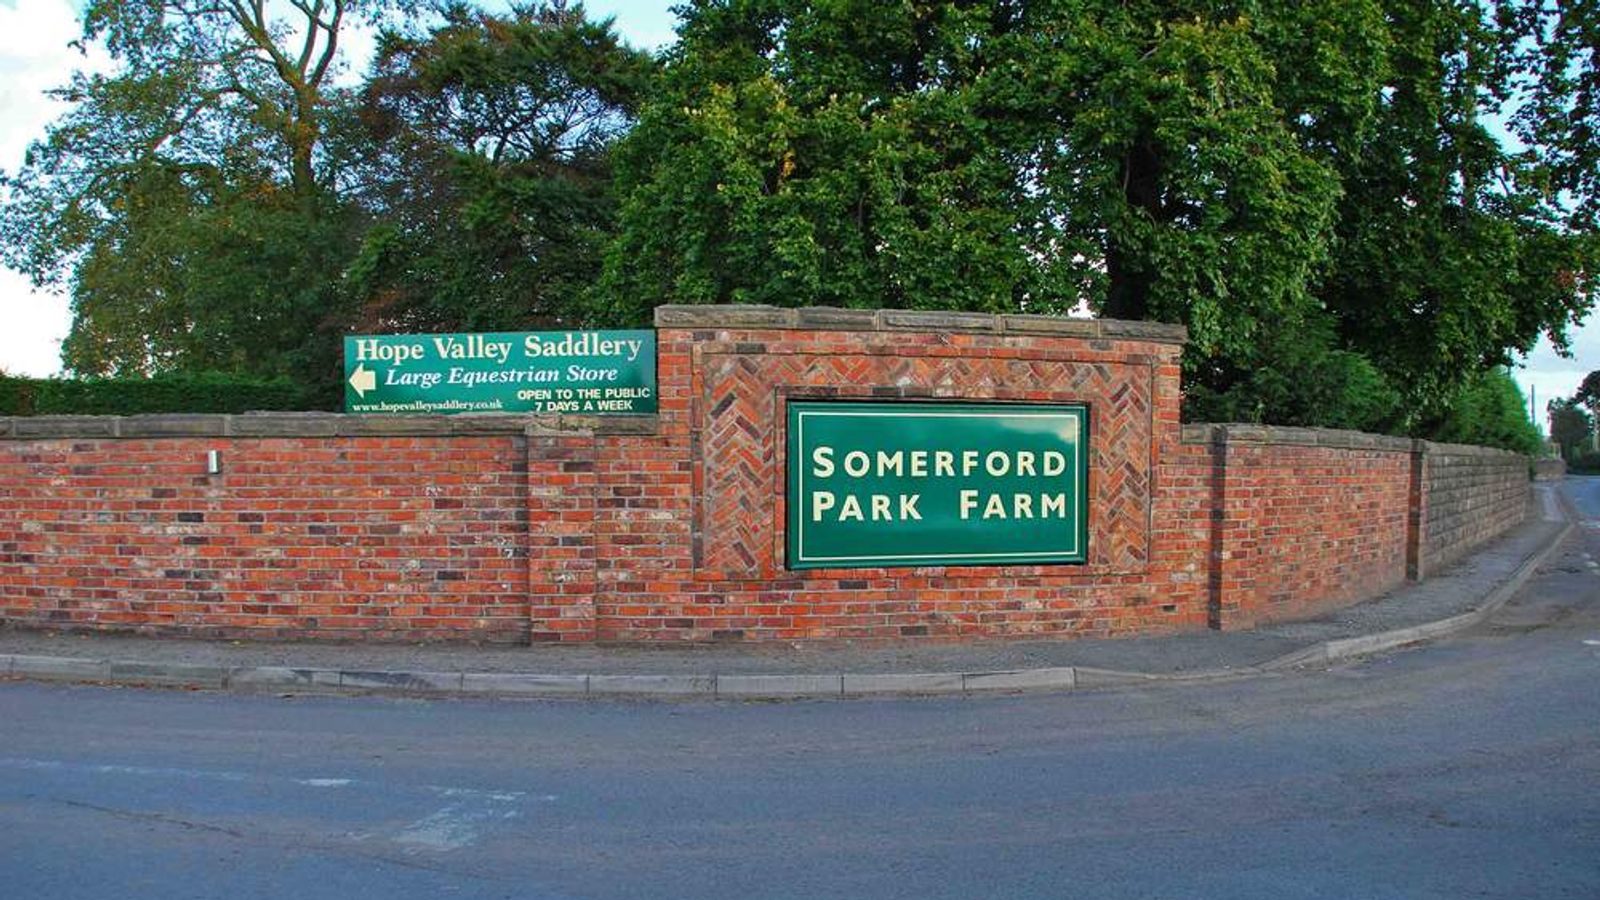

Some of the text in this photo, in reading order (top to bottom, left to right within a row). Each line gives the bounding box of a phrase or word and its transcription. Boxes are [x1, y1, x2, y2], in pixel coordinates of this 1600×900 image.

[356, 333, 642, 365] Hope Valley Saddlery
[384, 365, 618, 388] Large Equestrian Store
[517, 387, 650, 400] OPEN TO THE PUBLIC
[352, 399, 503, 413] www.hopevalleysaddlery.co.uk
[535, 400, 633, 412] 7 DAYS A WEEK
[812, 446, 1066, 478] SOMERFORD
[812, 489, 1066, 522] PARK FARM
